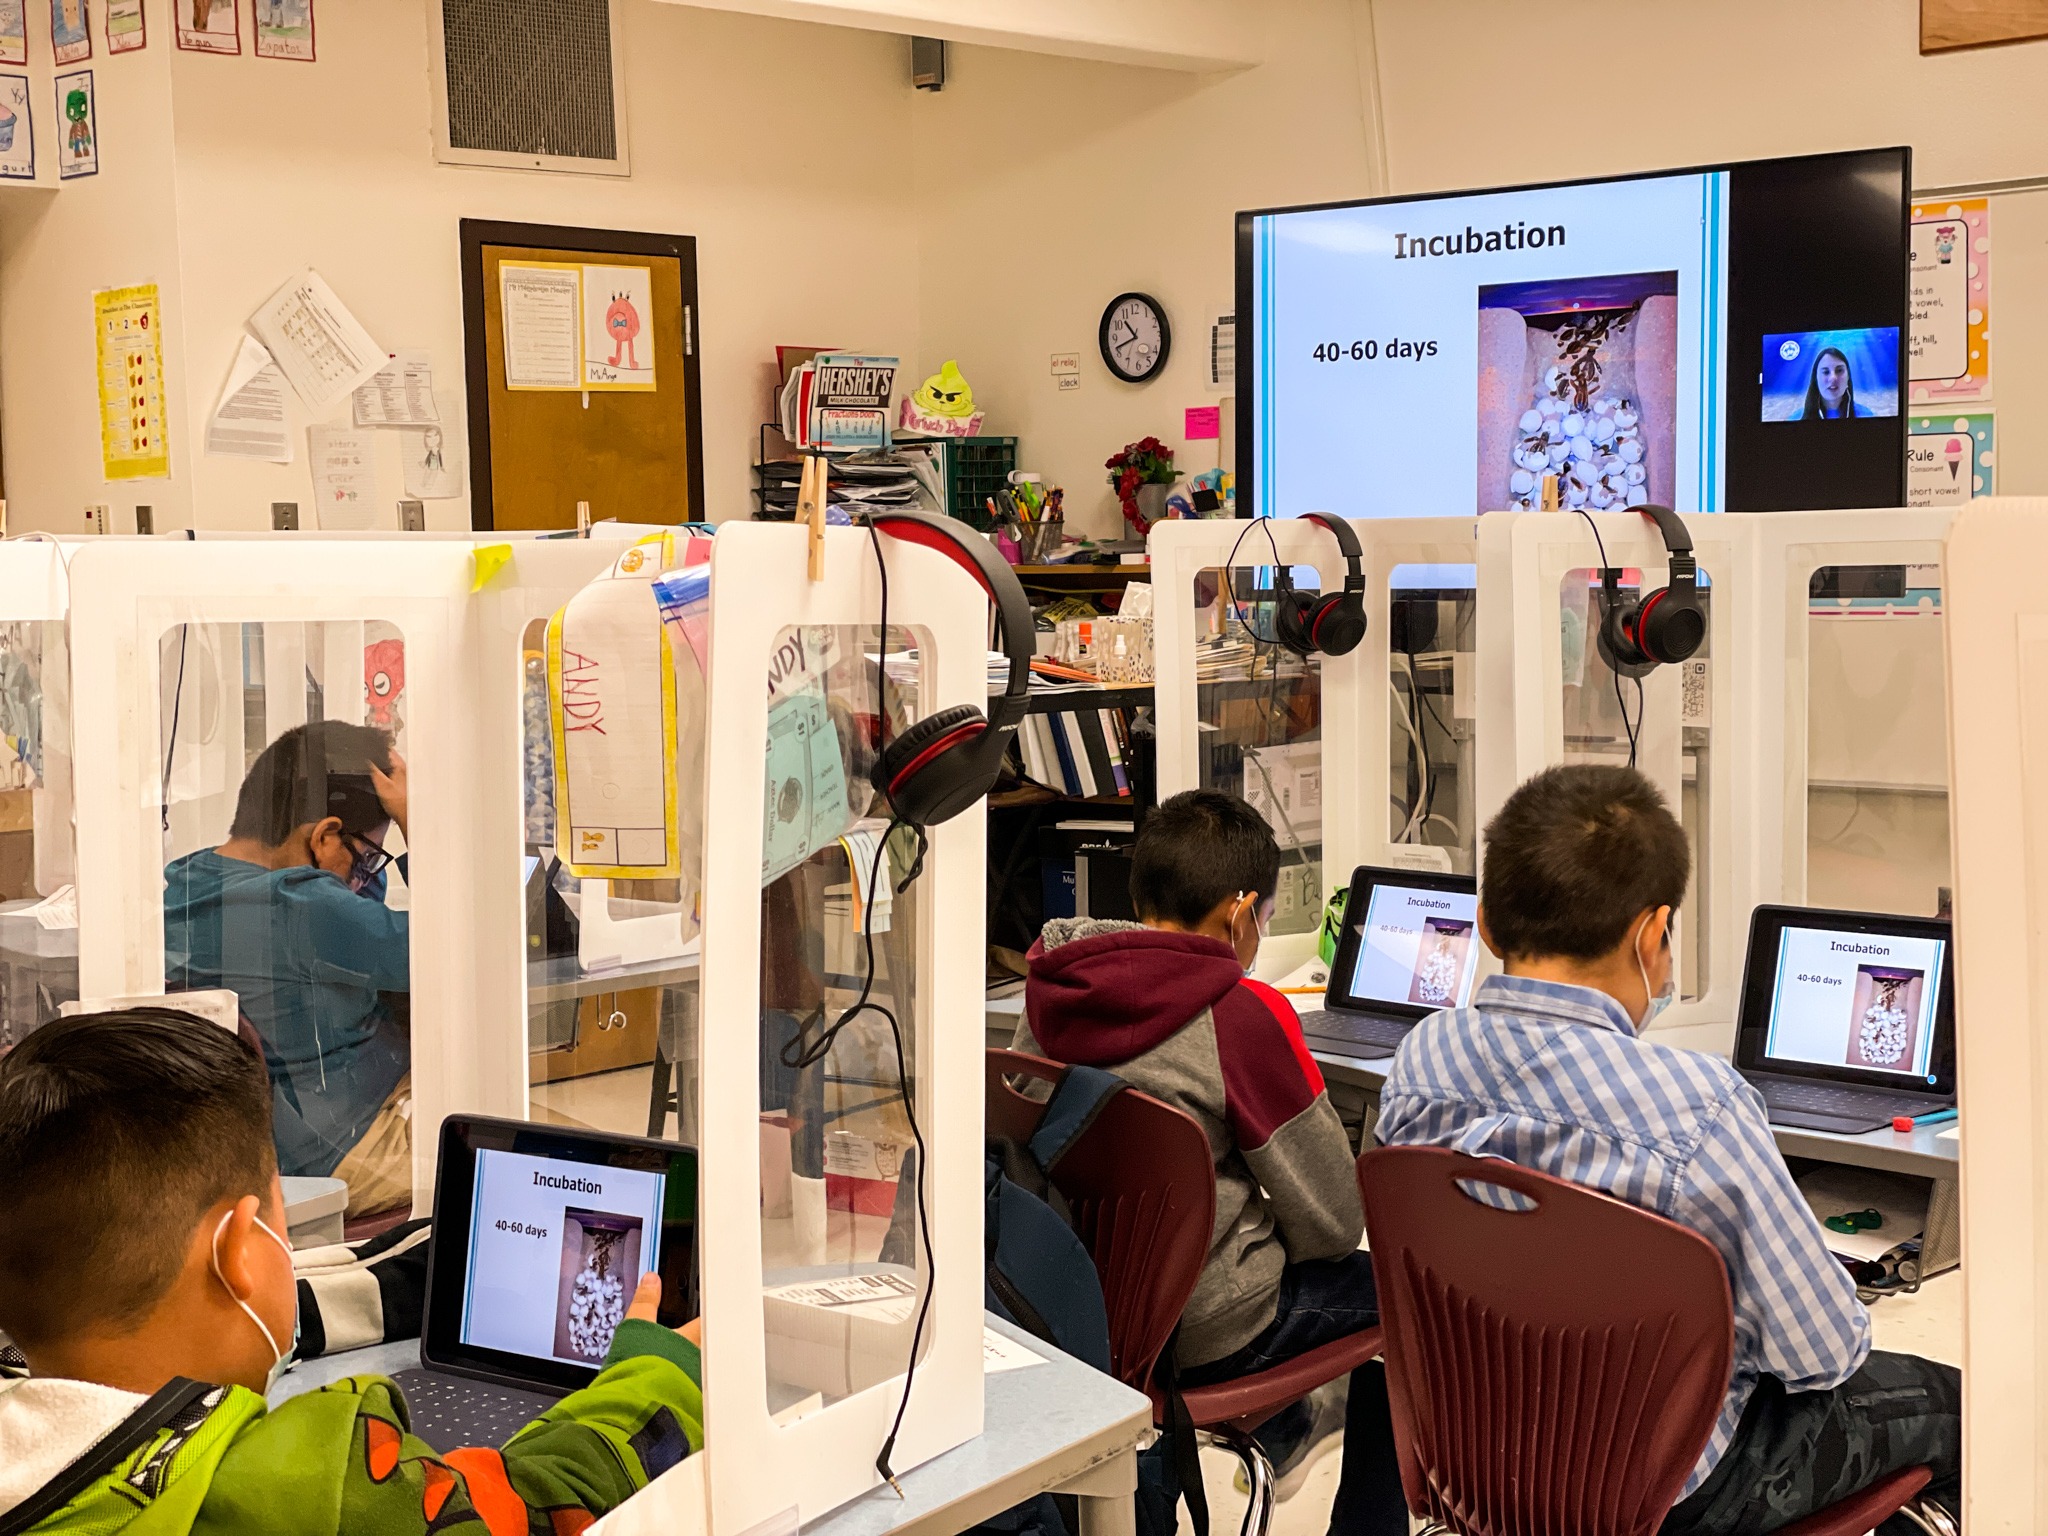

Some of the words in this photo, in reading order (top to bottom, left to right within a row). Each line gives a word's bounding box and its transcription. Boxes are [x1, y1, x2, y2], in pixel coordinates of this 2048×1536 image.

[2, 161, 33, 175] gurt
[1394, 221, 1566, 260] Incubation
[1122, 308, 1129, 320] 11
[1131, 303, 1140, 315] 12
[1145, 306, 1148, 318] 1
[124, 319, 129, 329] 2
[1114, 319, 1123, 331] 10
[1152, 316, 1158, 329] 2
[1112, 333, 1118, 344] 9
[1152, 344, 1158, 356] 4
[1313, 340, 1378, 362] 40-60
[1385, 338, 1438, 362] days
[1125, 357, 1130, 370] 7
[1136, 359, 1142, 371] 6
[1146, 356, 1152, 368] 5
[820, 367, 892, 396] HERSHEY'S
[1910, 488, 1932, 496] short
[1935, 486, 1960, 496] vowel
[563, 648, 607, 735] ANDY
[1407, 896, 1451, 910] Incubation
[1398, 927, 1413, 936] days
[1830, 941, 1890, 956] Incubation
[1797, 974, 1821, 984] 40-60
[1822, 976, 1842, 987] days
[533, 1171, 602, 1195] Incubation
[495, 1219, 523, 1233] 40-60
[525, 1224, 547, 1239] days
